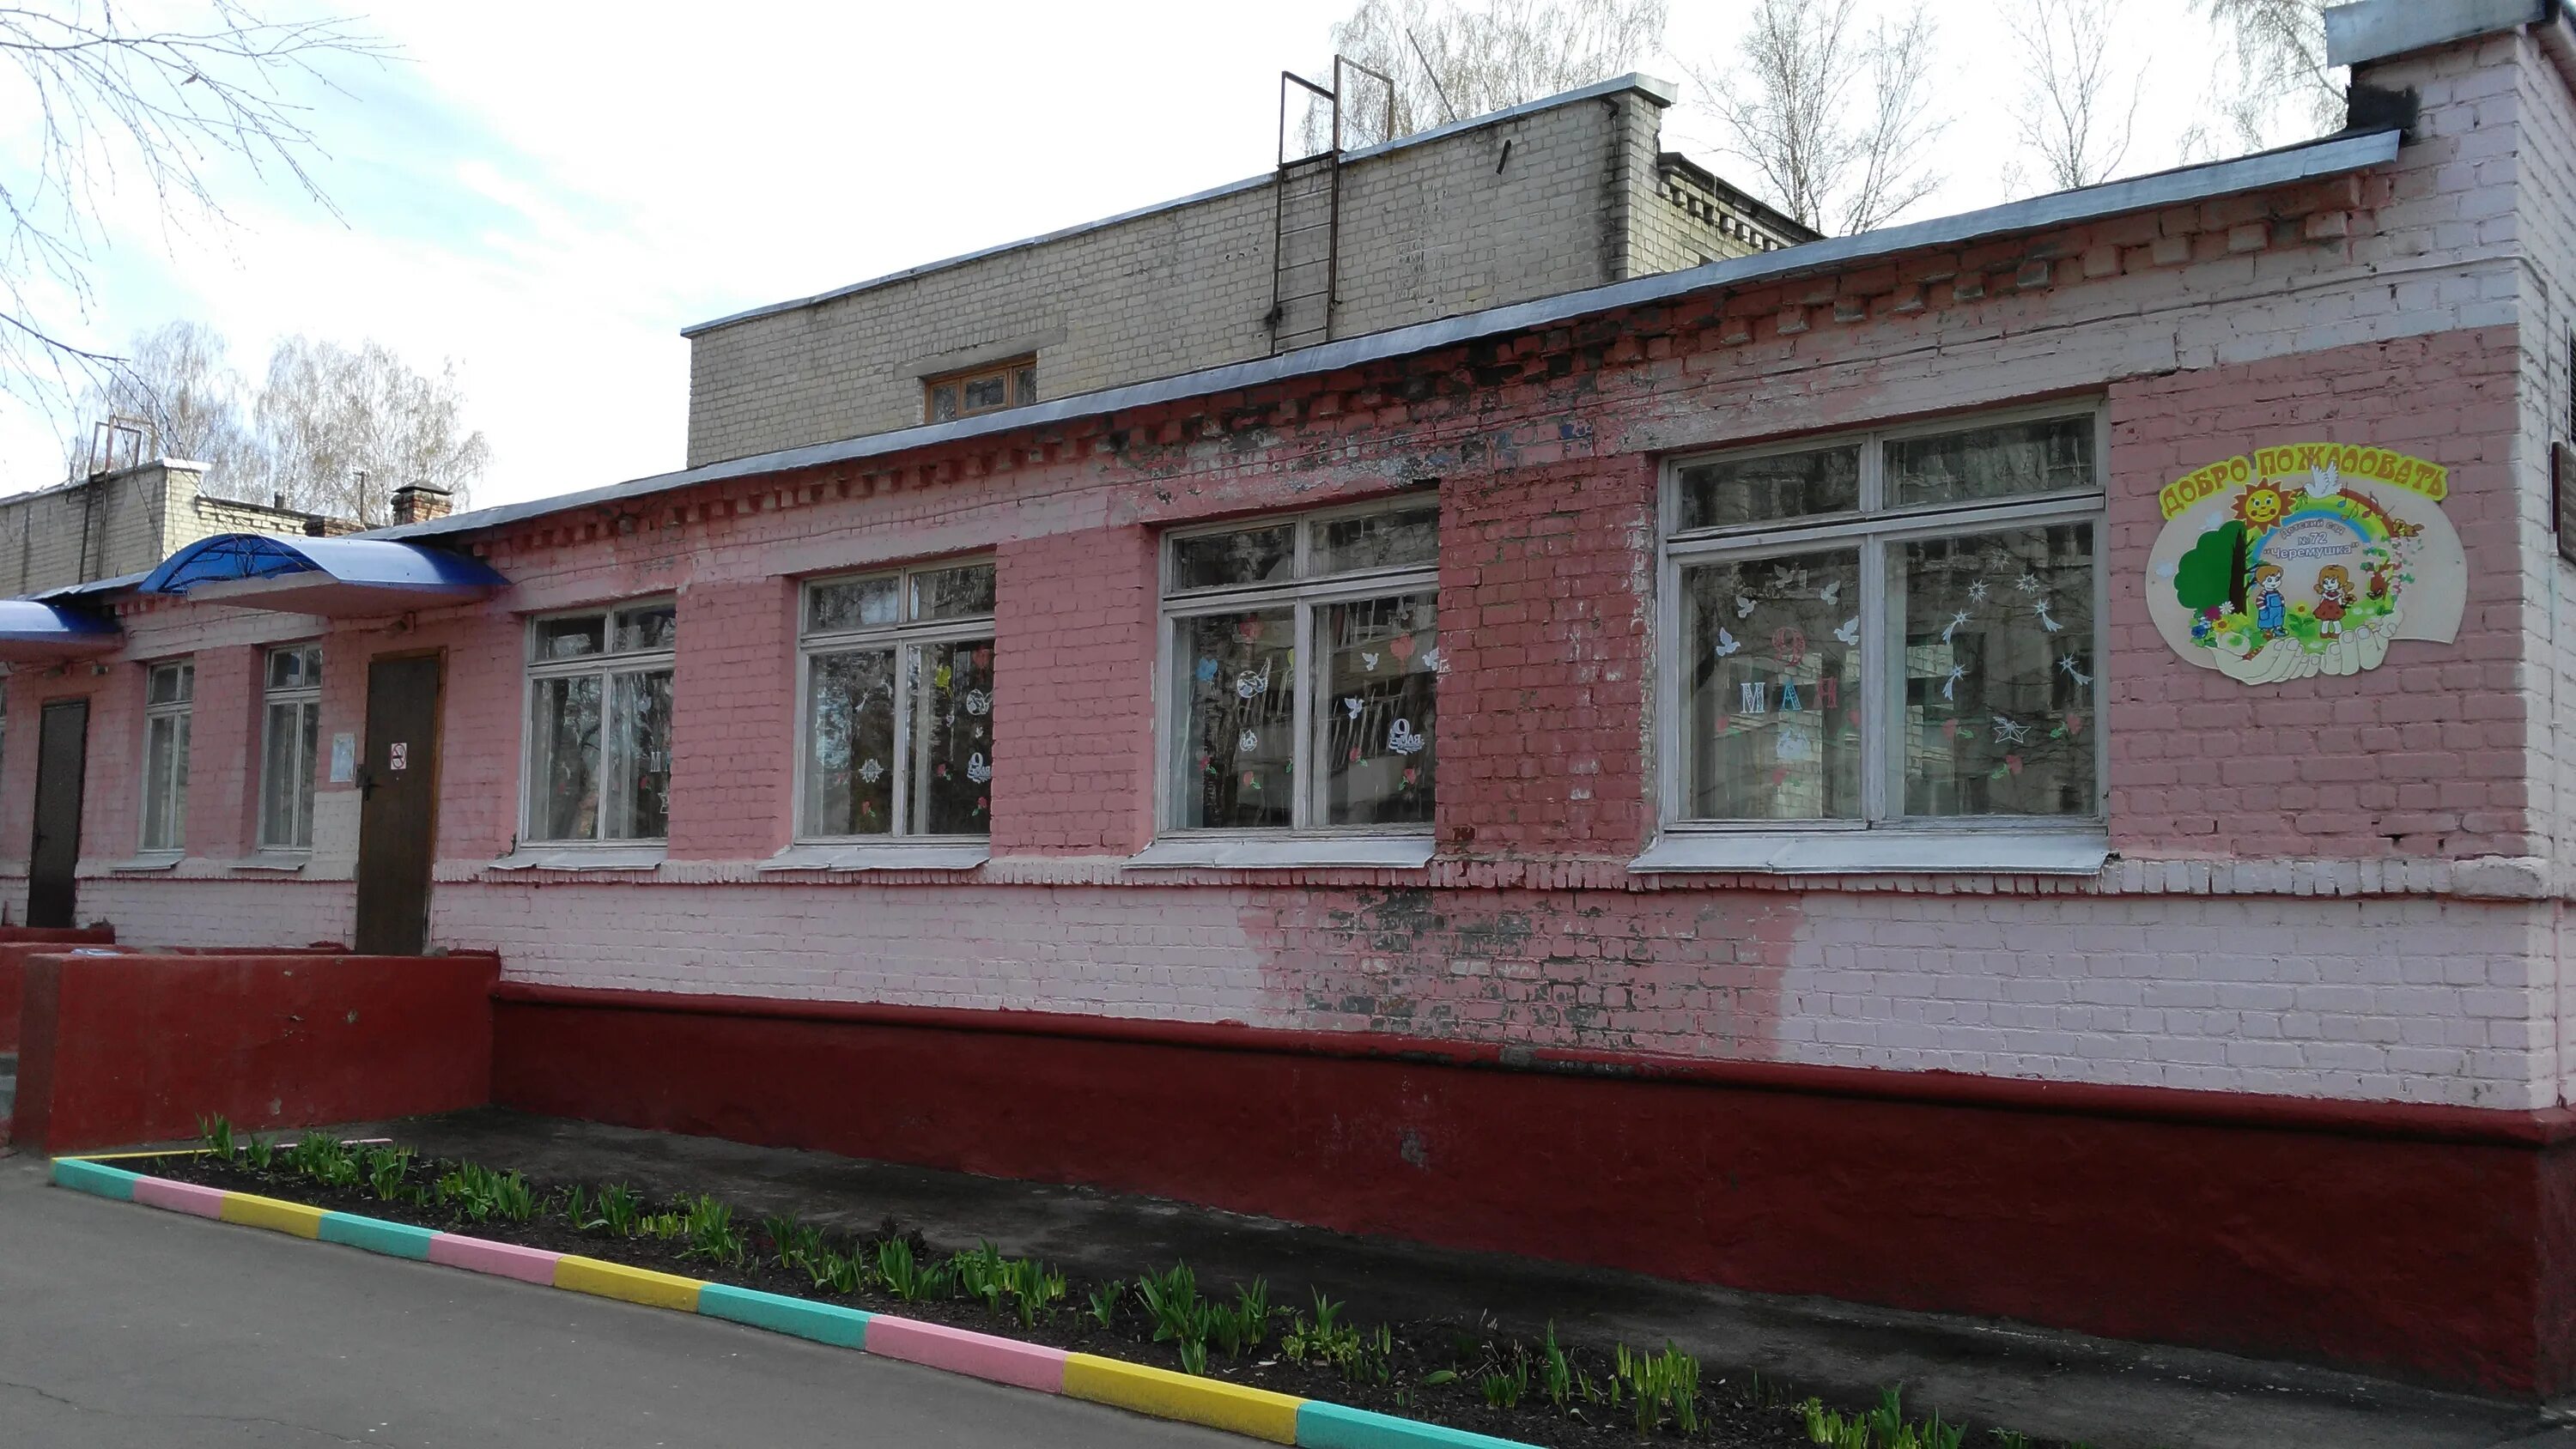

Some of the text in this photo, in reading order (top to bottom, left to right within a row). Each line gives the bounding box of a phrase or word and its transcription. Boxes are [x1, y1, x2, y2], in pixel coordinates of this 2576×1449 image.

[2161, 446, 2445, 517] ДОБРО ПОЖАЛОВАТЬ
[1772, 627, 1807, 666] 9
